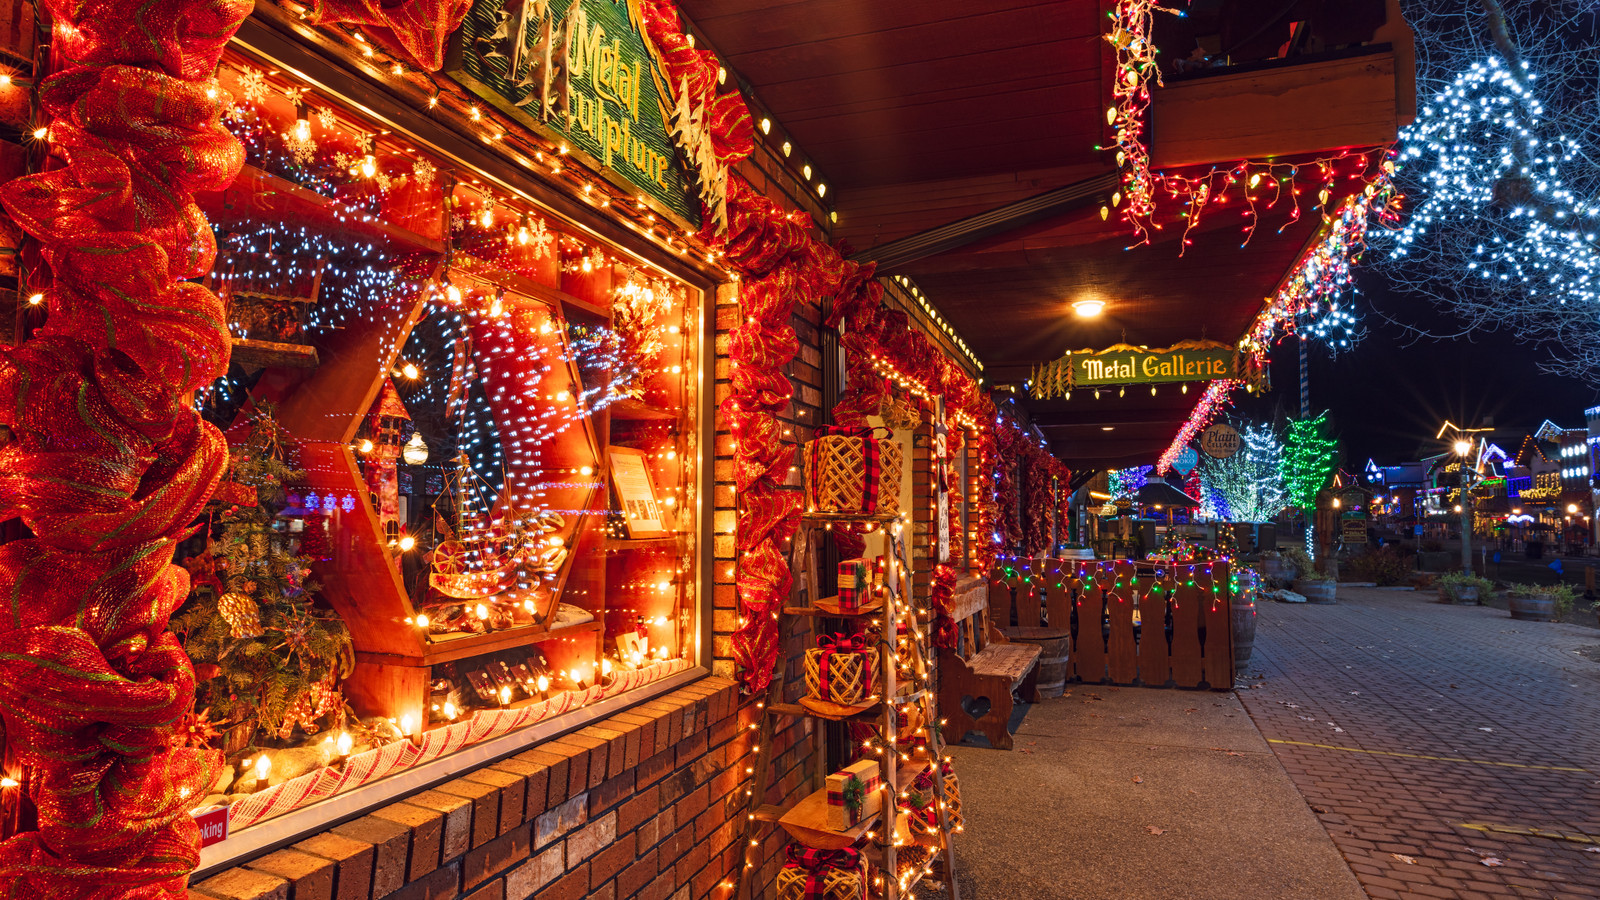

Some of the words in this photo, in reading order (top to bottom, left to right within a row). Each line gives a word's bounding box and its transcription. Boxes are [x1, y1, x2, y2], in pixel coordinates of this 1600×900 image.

[569, 9, 641, 123] Metal
[561, 86, 669, 191] culpture
[1082, 356, 1136, 380] Metal
[1142, 355, 1227, 377] Gallerie
[1207, 430, 1236, 442] Plain
